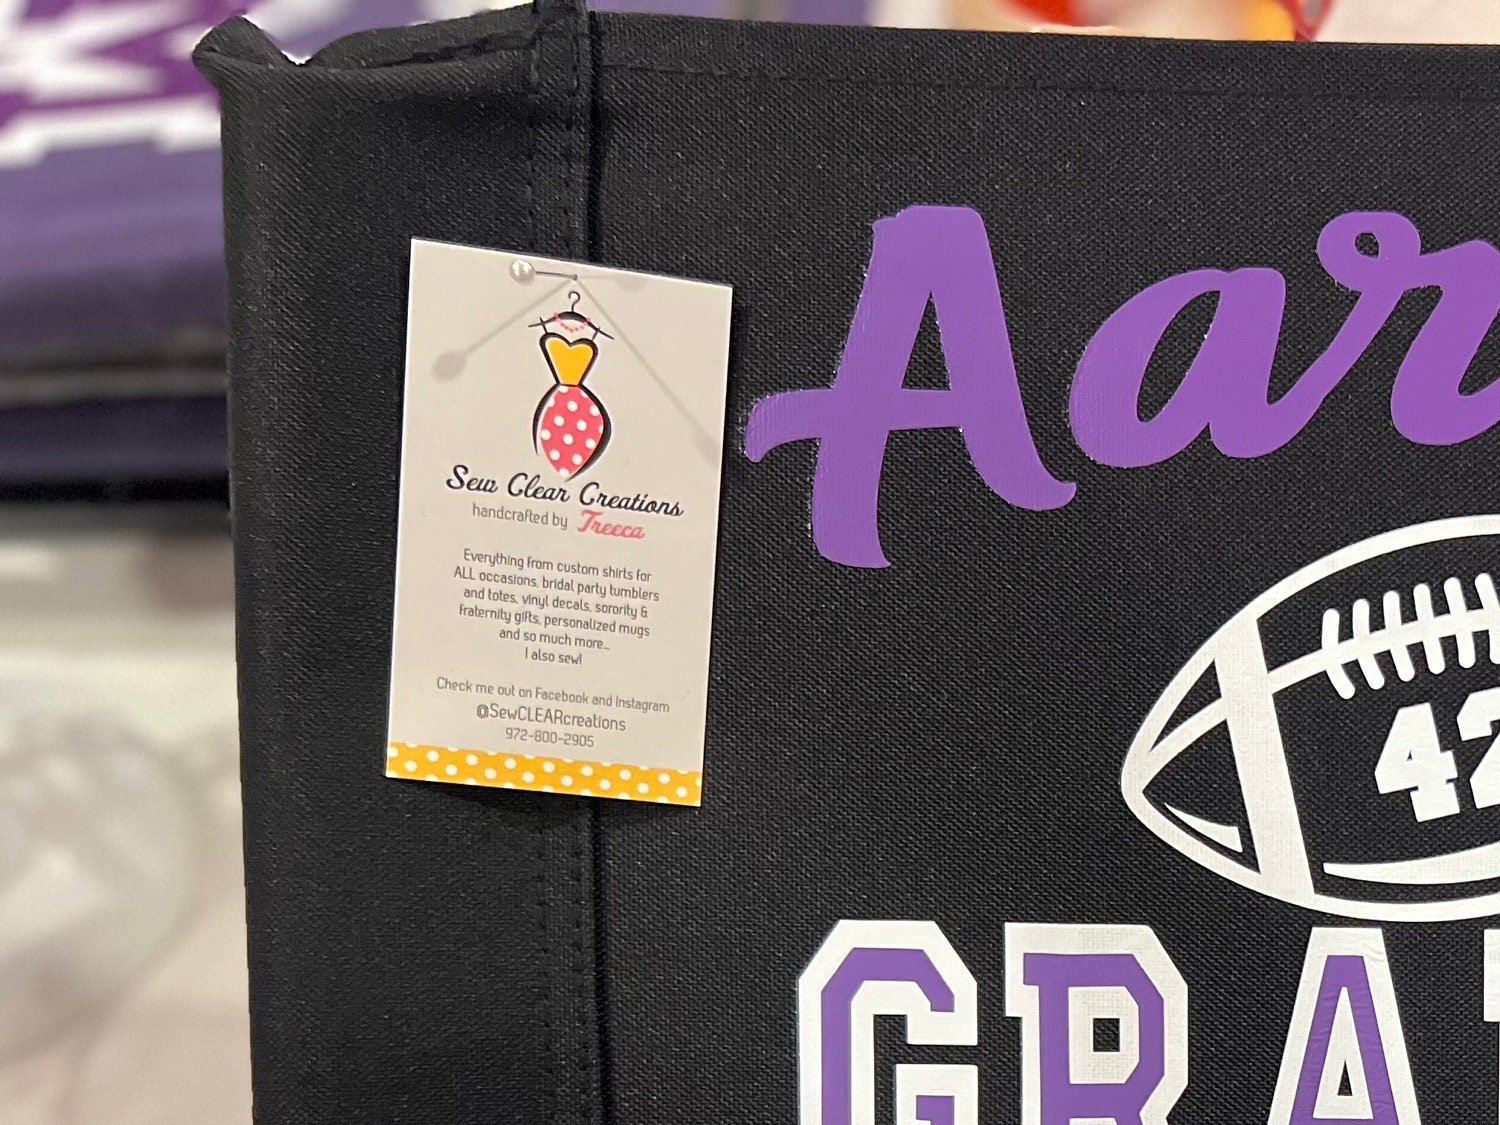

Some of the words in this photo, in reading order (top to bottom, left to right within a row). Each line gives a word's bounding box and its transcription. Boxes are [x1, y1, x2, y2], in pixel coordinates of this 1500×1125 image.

[446, 464, 498, 493] Sew
[507, 472, 570, 502] Clear
[579, 482, 684, 516] Creations
[473, 503, 549, 526] handcrafted
[552, 513, 568, 530] by
[577, 509, 645, 539] Treeca
[464, 548, 524, 570] Everything
[527, 556, 553, 570] from
[557, 561, 599, 576] custom
[603, 566, 633, 580] shirts
[637, 569, 652, 582] for
[454, 566, 475, 580] ALL
[543, 576, 574, 592] bridal
[577, 583, 606, 598] party
[610, 584, 659, 601] tumblers
[464, 586, 484, 600] and
[522, 594, 549, 609] vinyl
[595, 603, 637, 620] sorority
[641, 606, 648, 617] &
[459, 604, 511, 624] fraternity
[544, 615, 615, 632] personalized
[619, 624, 650, 638] mugs
[499, 628, 520, 641] and
[524, 631, 536, 641] so
[540, 632, 571, 646] much
[525, 647, 528, 659] I
[532, 649, 555, 662] also
[437, 677, 473, 692] Check
[476, 683, 494, 694] me
[498, 685, 516, 696] out
[519, 687, 532, 698] on
[535, 688, 588, 704] Facebook
[592, 694, 612, 706] and
[616, 695, 670, 713] Instagram
[477, 703, 626, 731] @SewCLEARcreations
[506, 727, 594, 747] 972-800-2905
